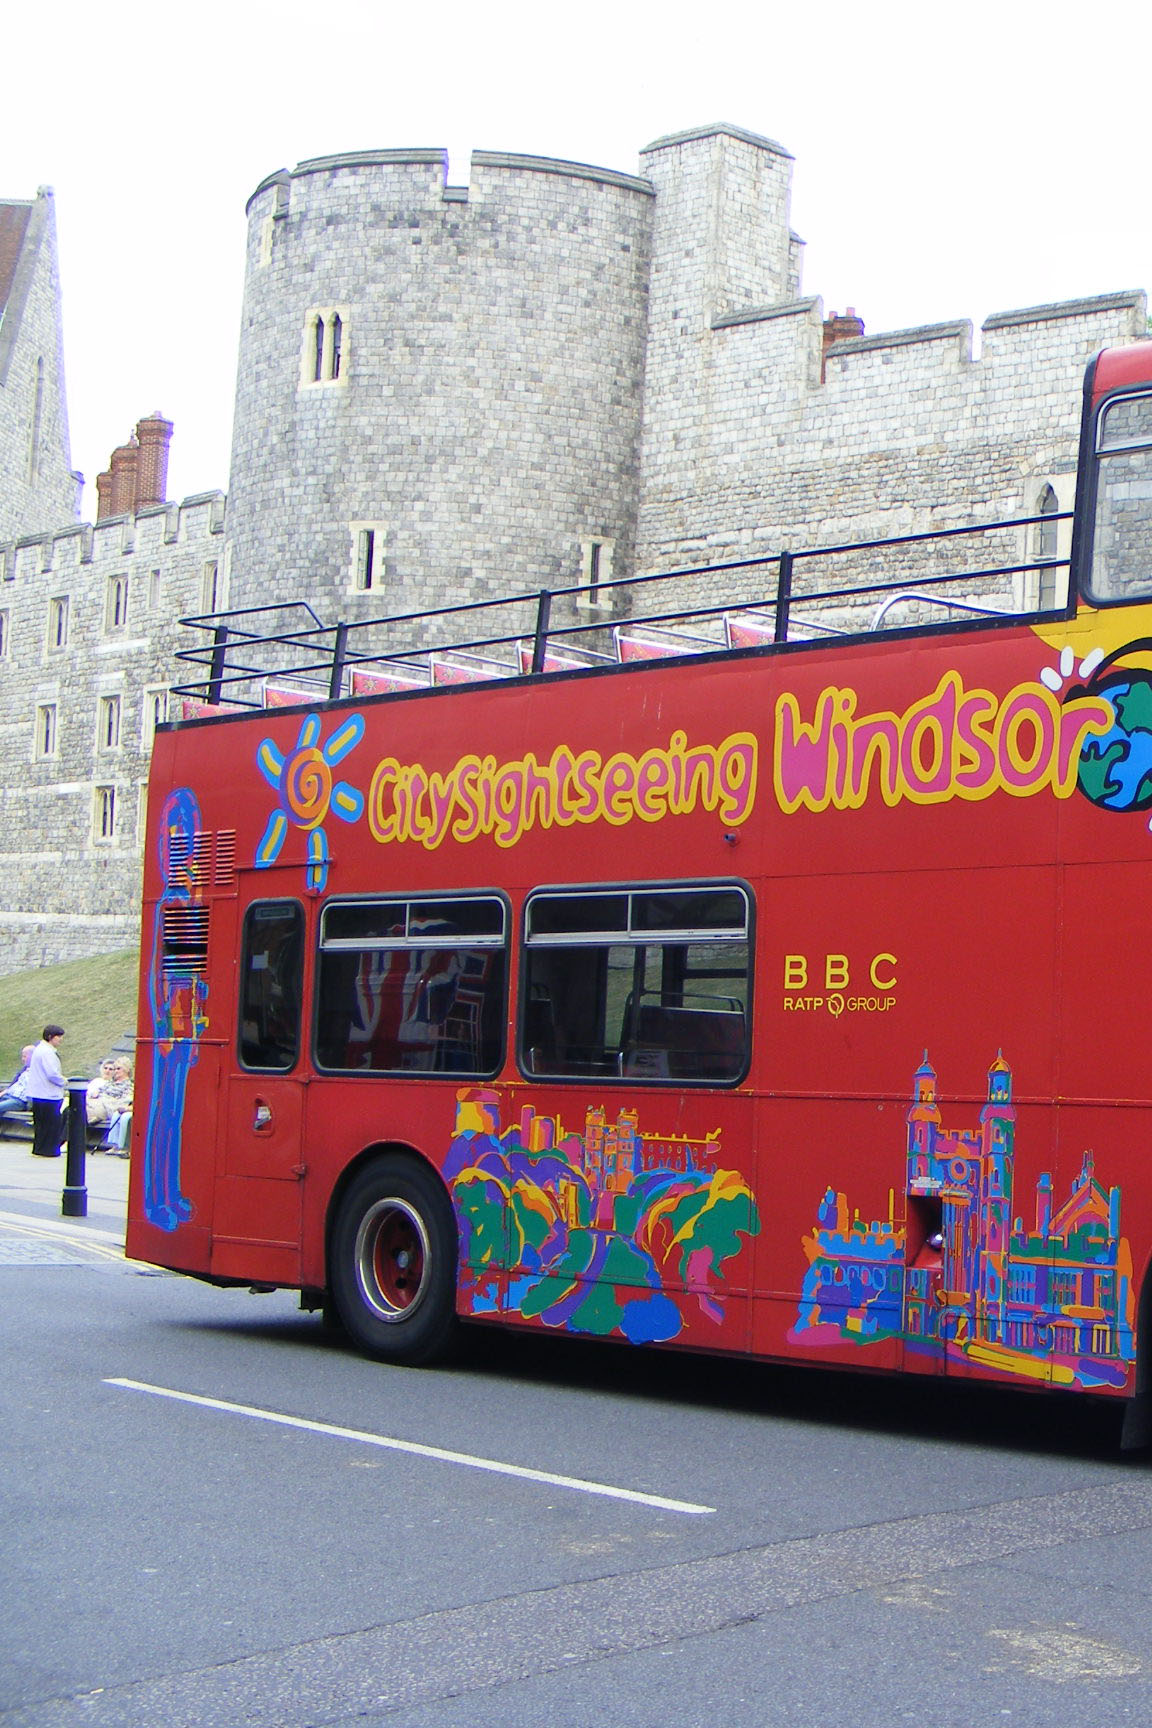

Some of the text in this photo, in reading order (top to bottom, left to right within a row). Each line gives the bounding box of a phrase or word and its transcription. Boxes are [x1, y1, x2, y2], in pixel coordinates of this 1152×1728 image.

[774, 670, 1116, 815] Windsor
[783, 997, 897, 1012] RATP GROUP
